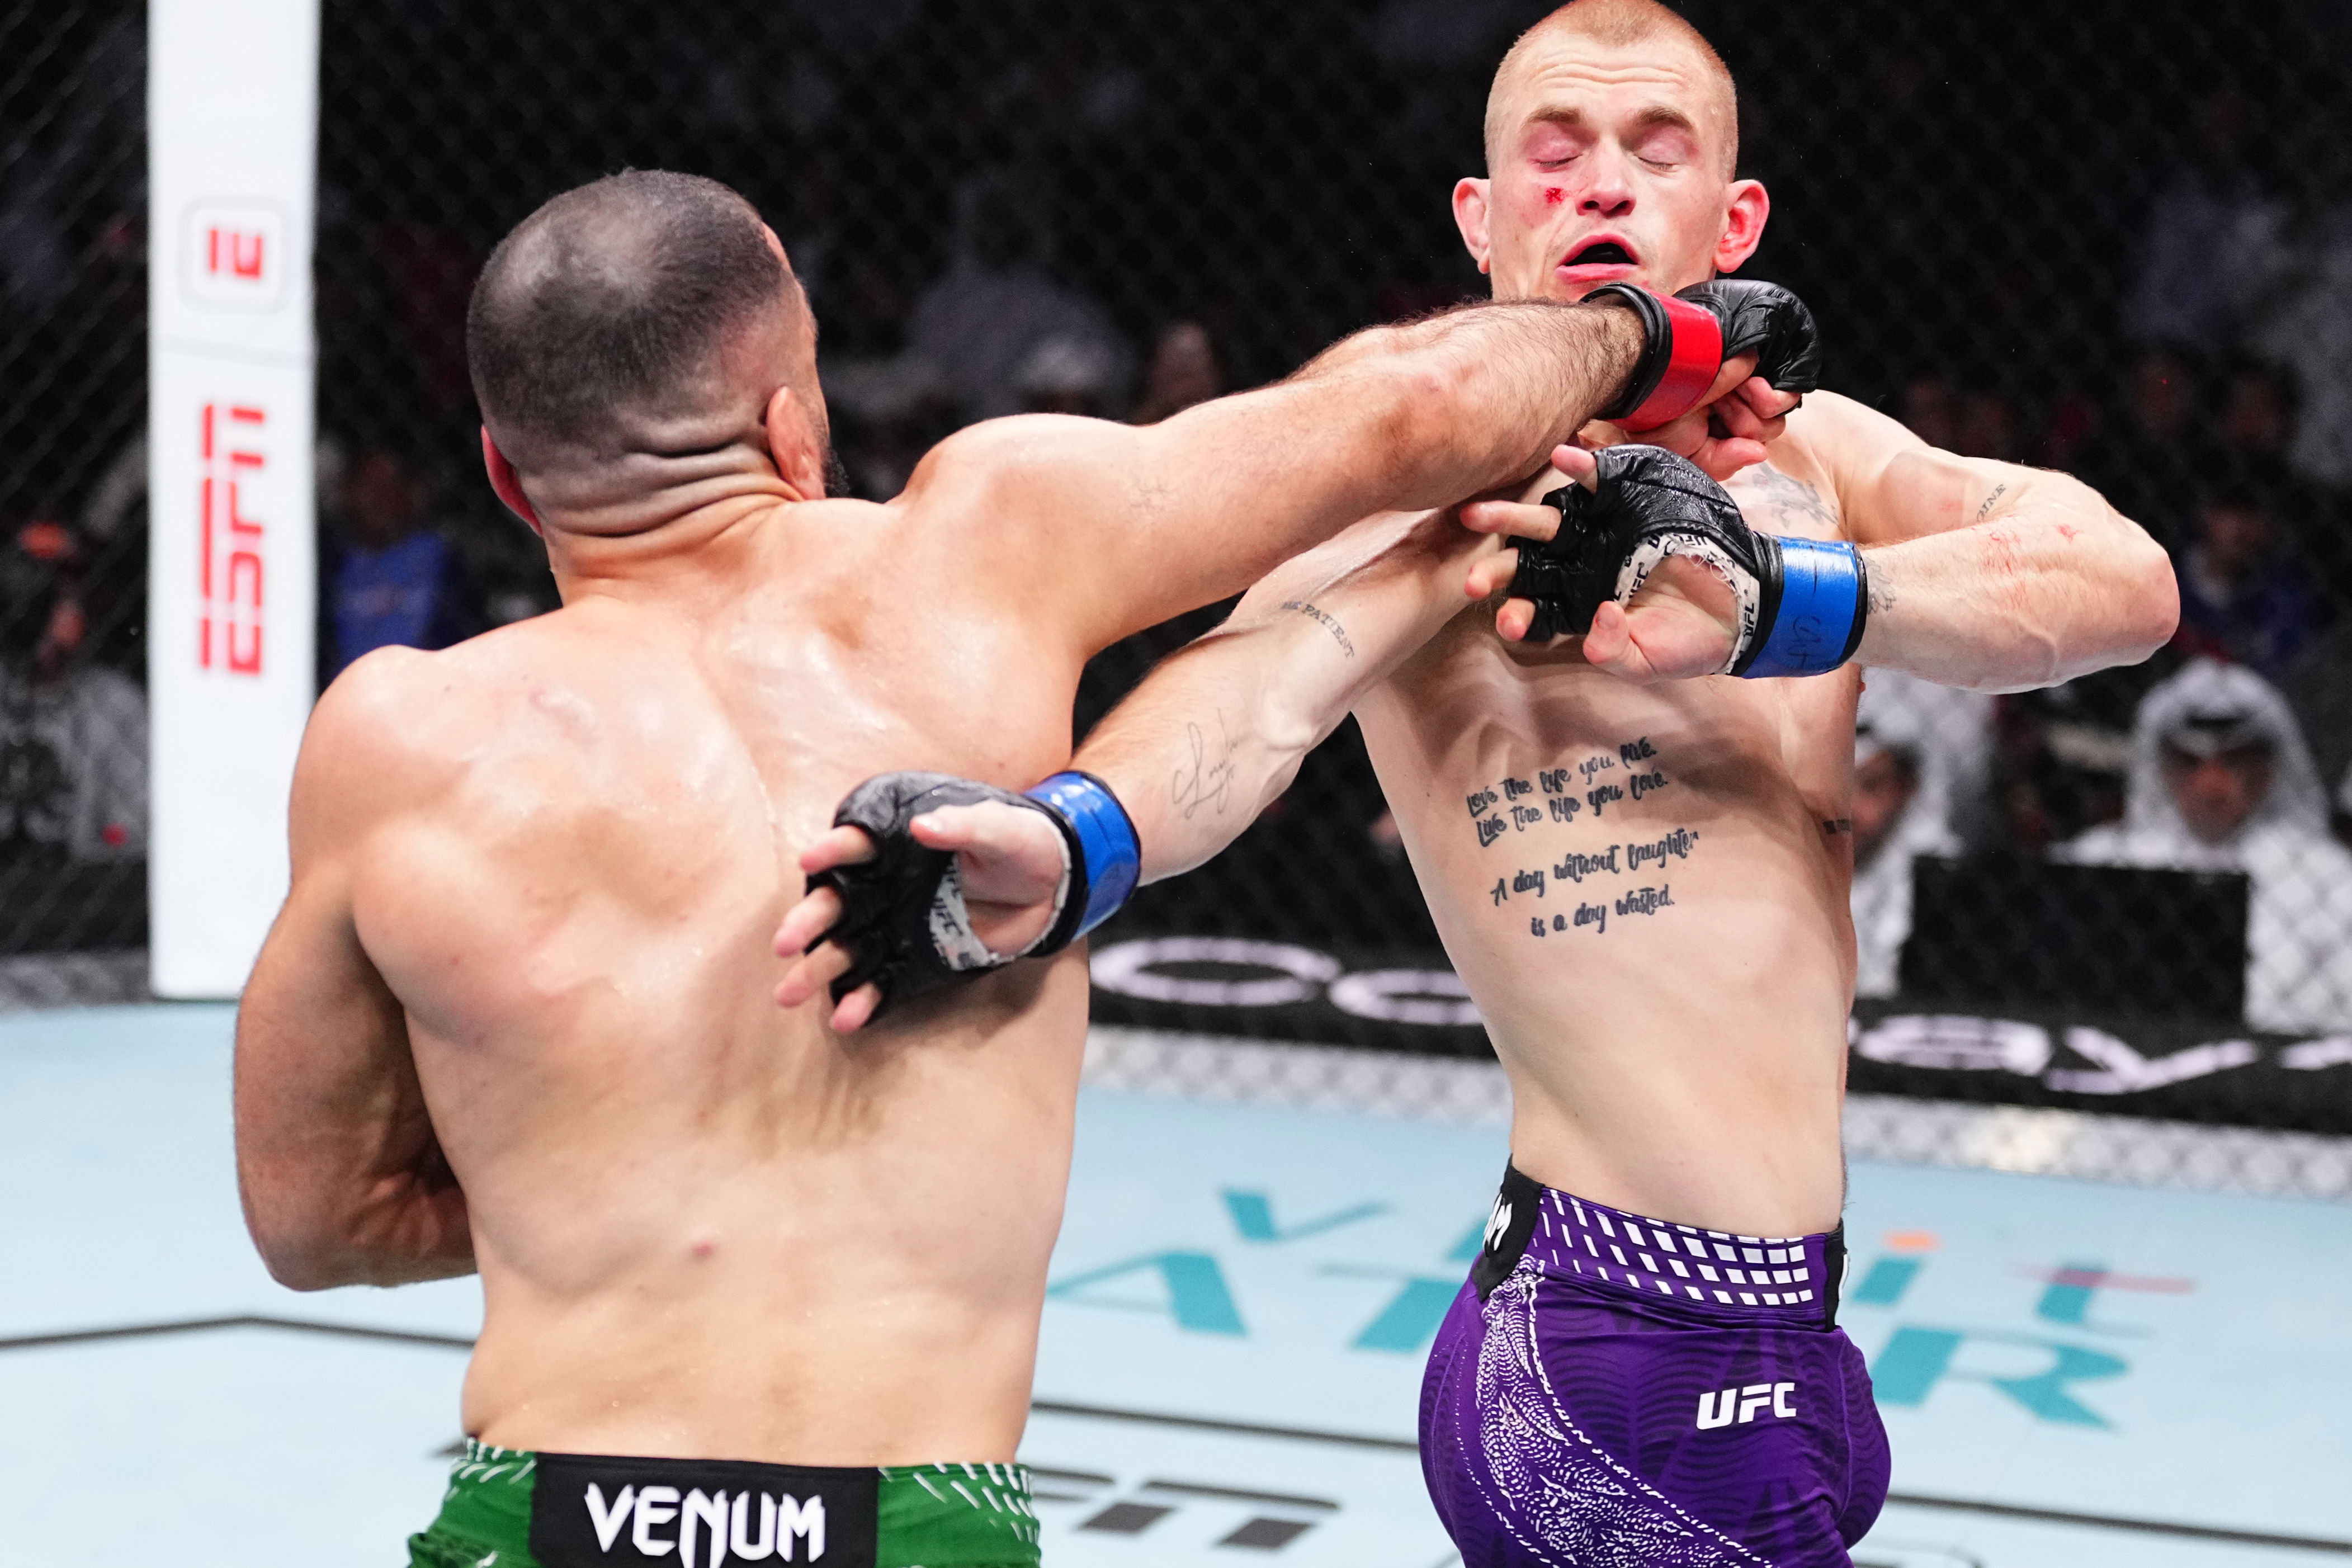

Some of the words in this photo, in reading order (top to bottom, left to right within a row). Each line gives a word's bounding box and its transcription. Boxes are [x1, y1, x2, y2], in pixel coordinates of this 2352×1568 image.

[200, 403, 265, 676] ESPN
[1302, 603, 1355, 658] PATIENT
[1467, 786, 1498, 818] Love
[1539, 769, 1571, 794] life
[1579, 756, 1614, 785] you
[1476, 813, 1508, 847] Live
[1549, 797, 1581, 823] life
[1588, 785, 1623, 816] you
[1490, 878, 1508, 906] A
[1513, 870, 1545, 898] day
[1553, 844, 1621, 883] without
[1627, 828, 1699, 870] laughter
[1531, 917, 1546, 937] is
[1553, 914, 1567, 932] a
[1574, 902, 1607, 934] day
[1696, 1382, 1797, 1430] UFC
[584, 1481, 826, 1568] VENUM
